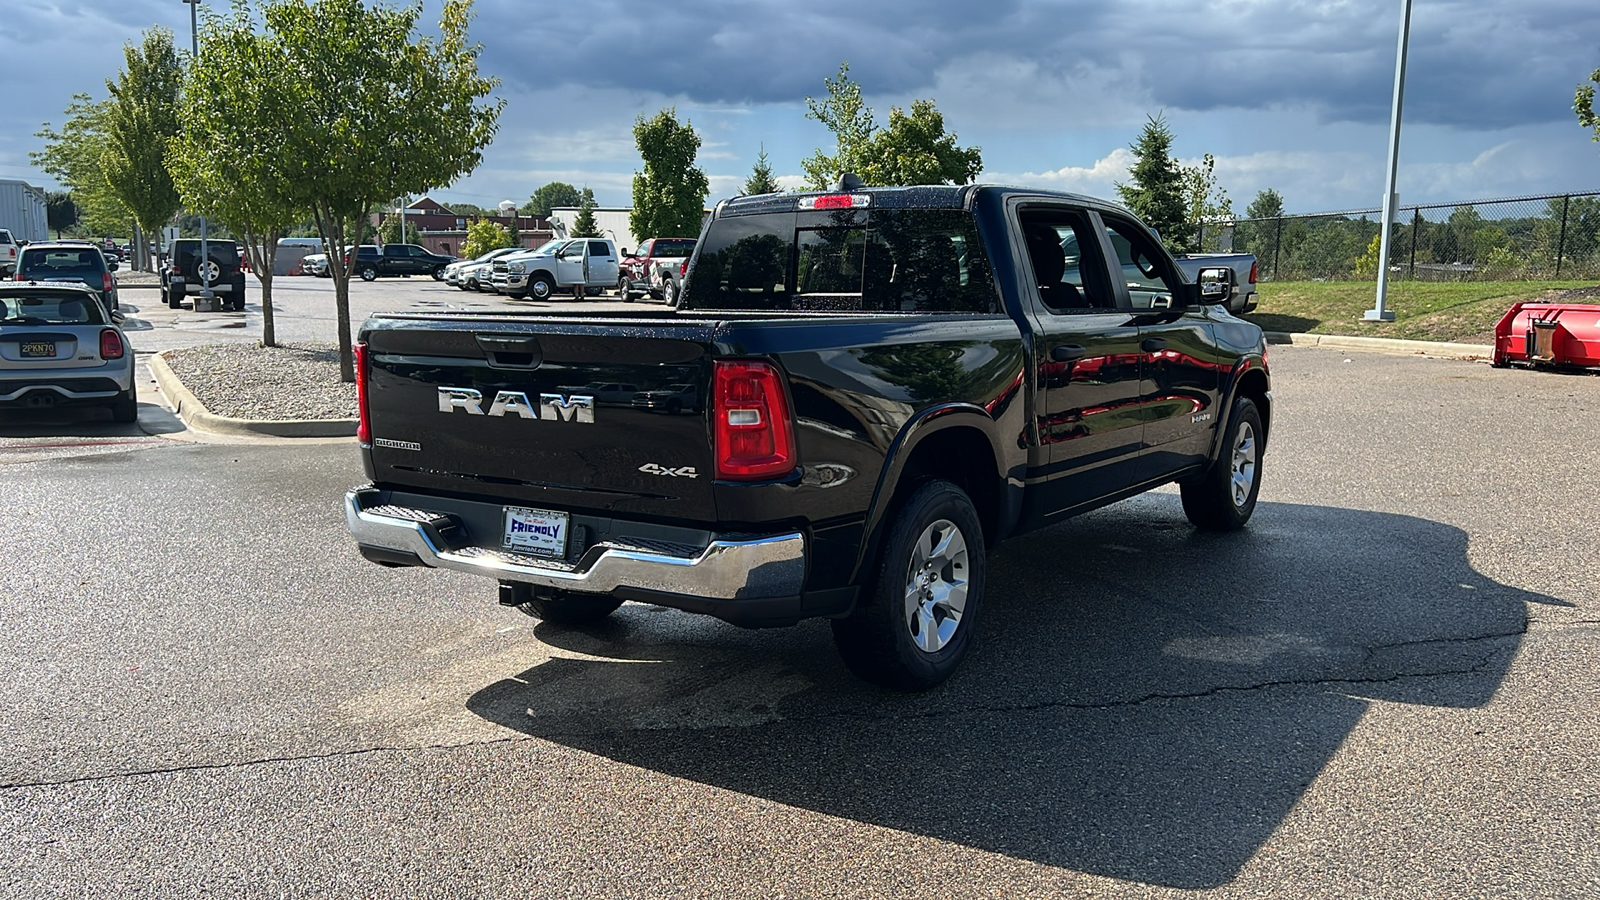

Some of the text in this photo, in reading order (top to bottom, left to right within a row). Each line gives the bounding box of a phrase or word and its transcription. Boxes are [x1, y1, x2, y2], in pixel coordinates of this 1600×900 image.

[22, 344, 54, 353] 2PKN70
[437, 386, 595, 424] RAM
[375, 438, 421, 451] BIGHORN
[638, 462, 700, 479] 4x4
[511, 518, 561, 539] FRIENDLY
[512, 544, 553, 555] jimriehl.com
